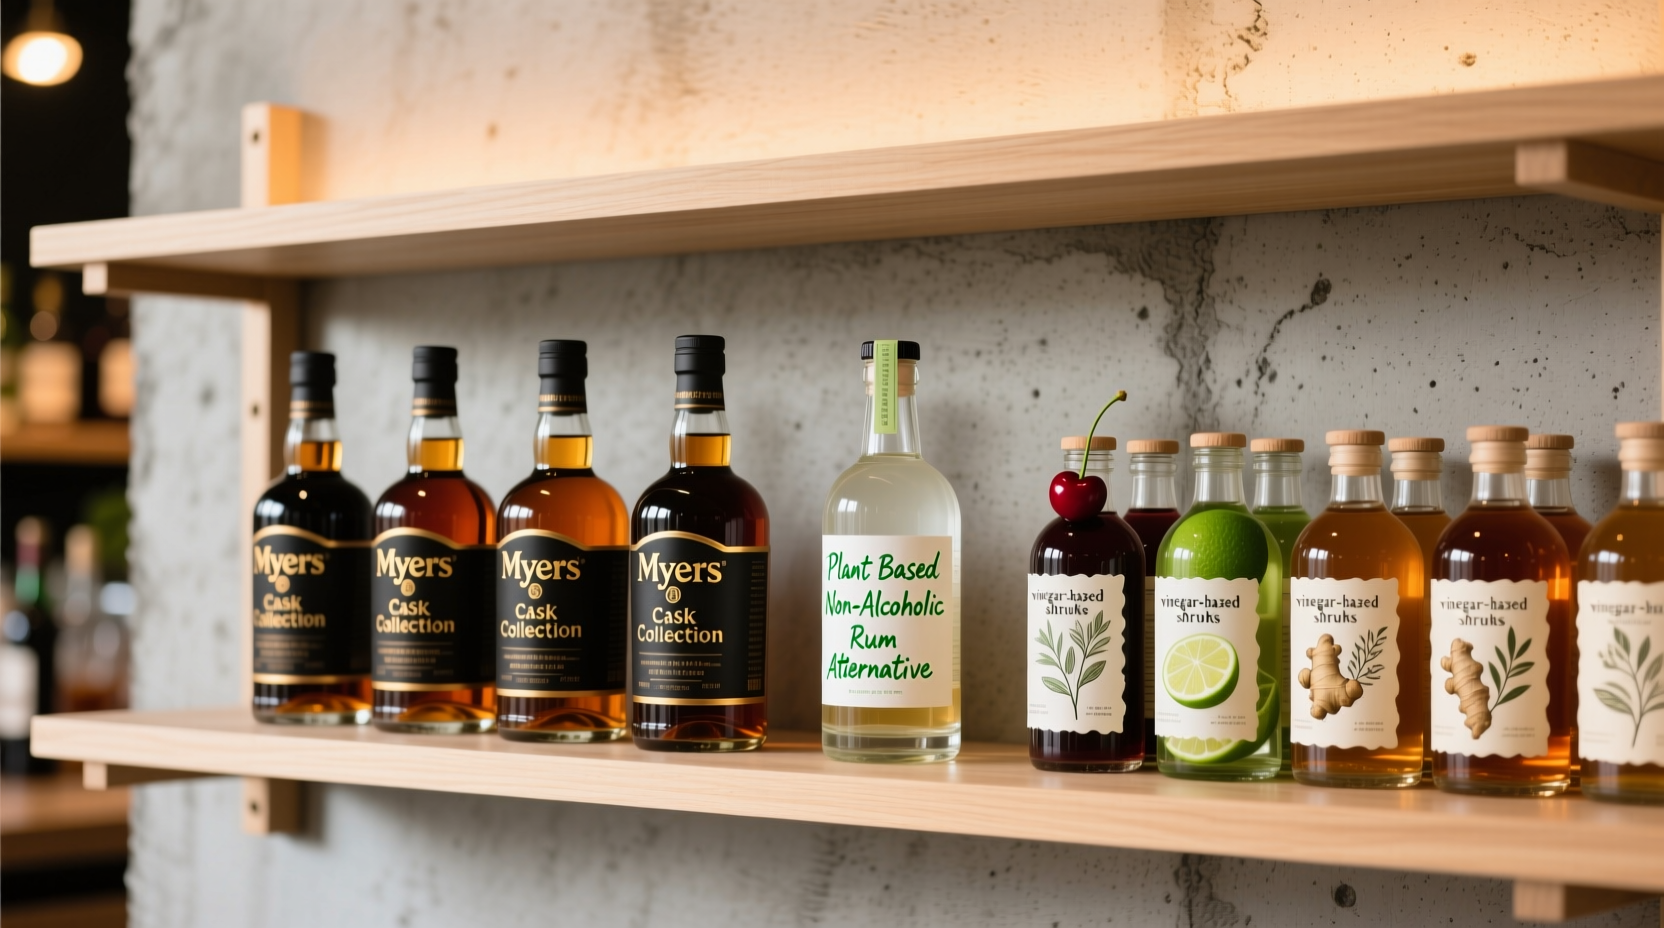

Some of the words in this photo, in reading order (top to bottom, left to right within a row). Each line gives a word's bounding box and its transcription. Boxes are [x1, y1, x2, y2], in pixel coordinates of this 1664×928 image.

[254, 545, 326, 583] Myers
[376, 548, 454, 586] Myers
[502, 550, 581, 588] Myers
[637, 552, 722, 590] Myers
[826, 551, 873, 581] Plant
[878, 550, 941, 581] Based
[652, 606, 697, 625] Cask
[826, 589, 945, 618] Non-Alcoholic
[376, 614, 455, 633] Collection
[501, 620, 582, 638] Collection
[637, 624, 723, 644] Collection
[850, 624, 897, 649] Rum
